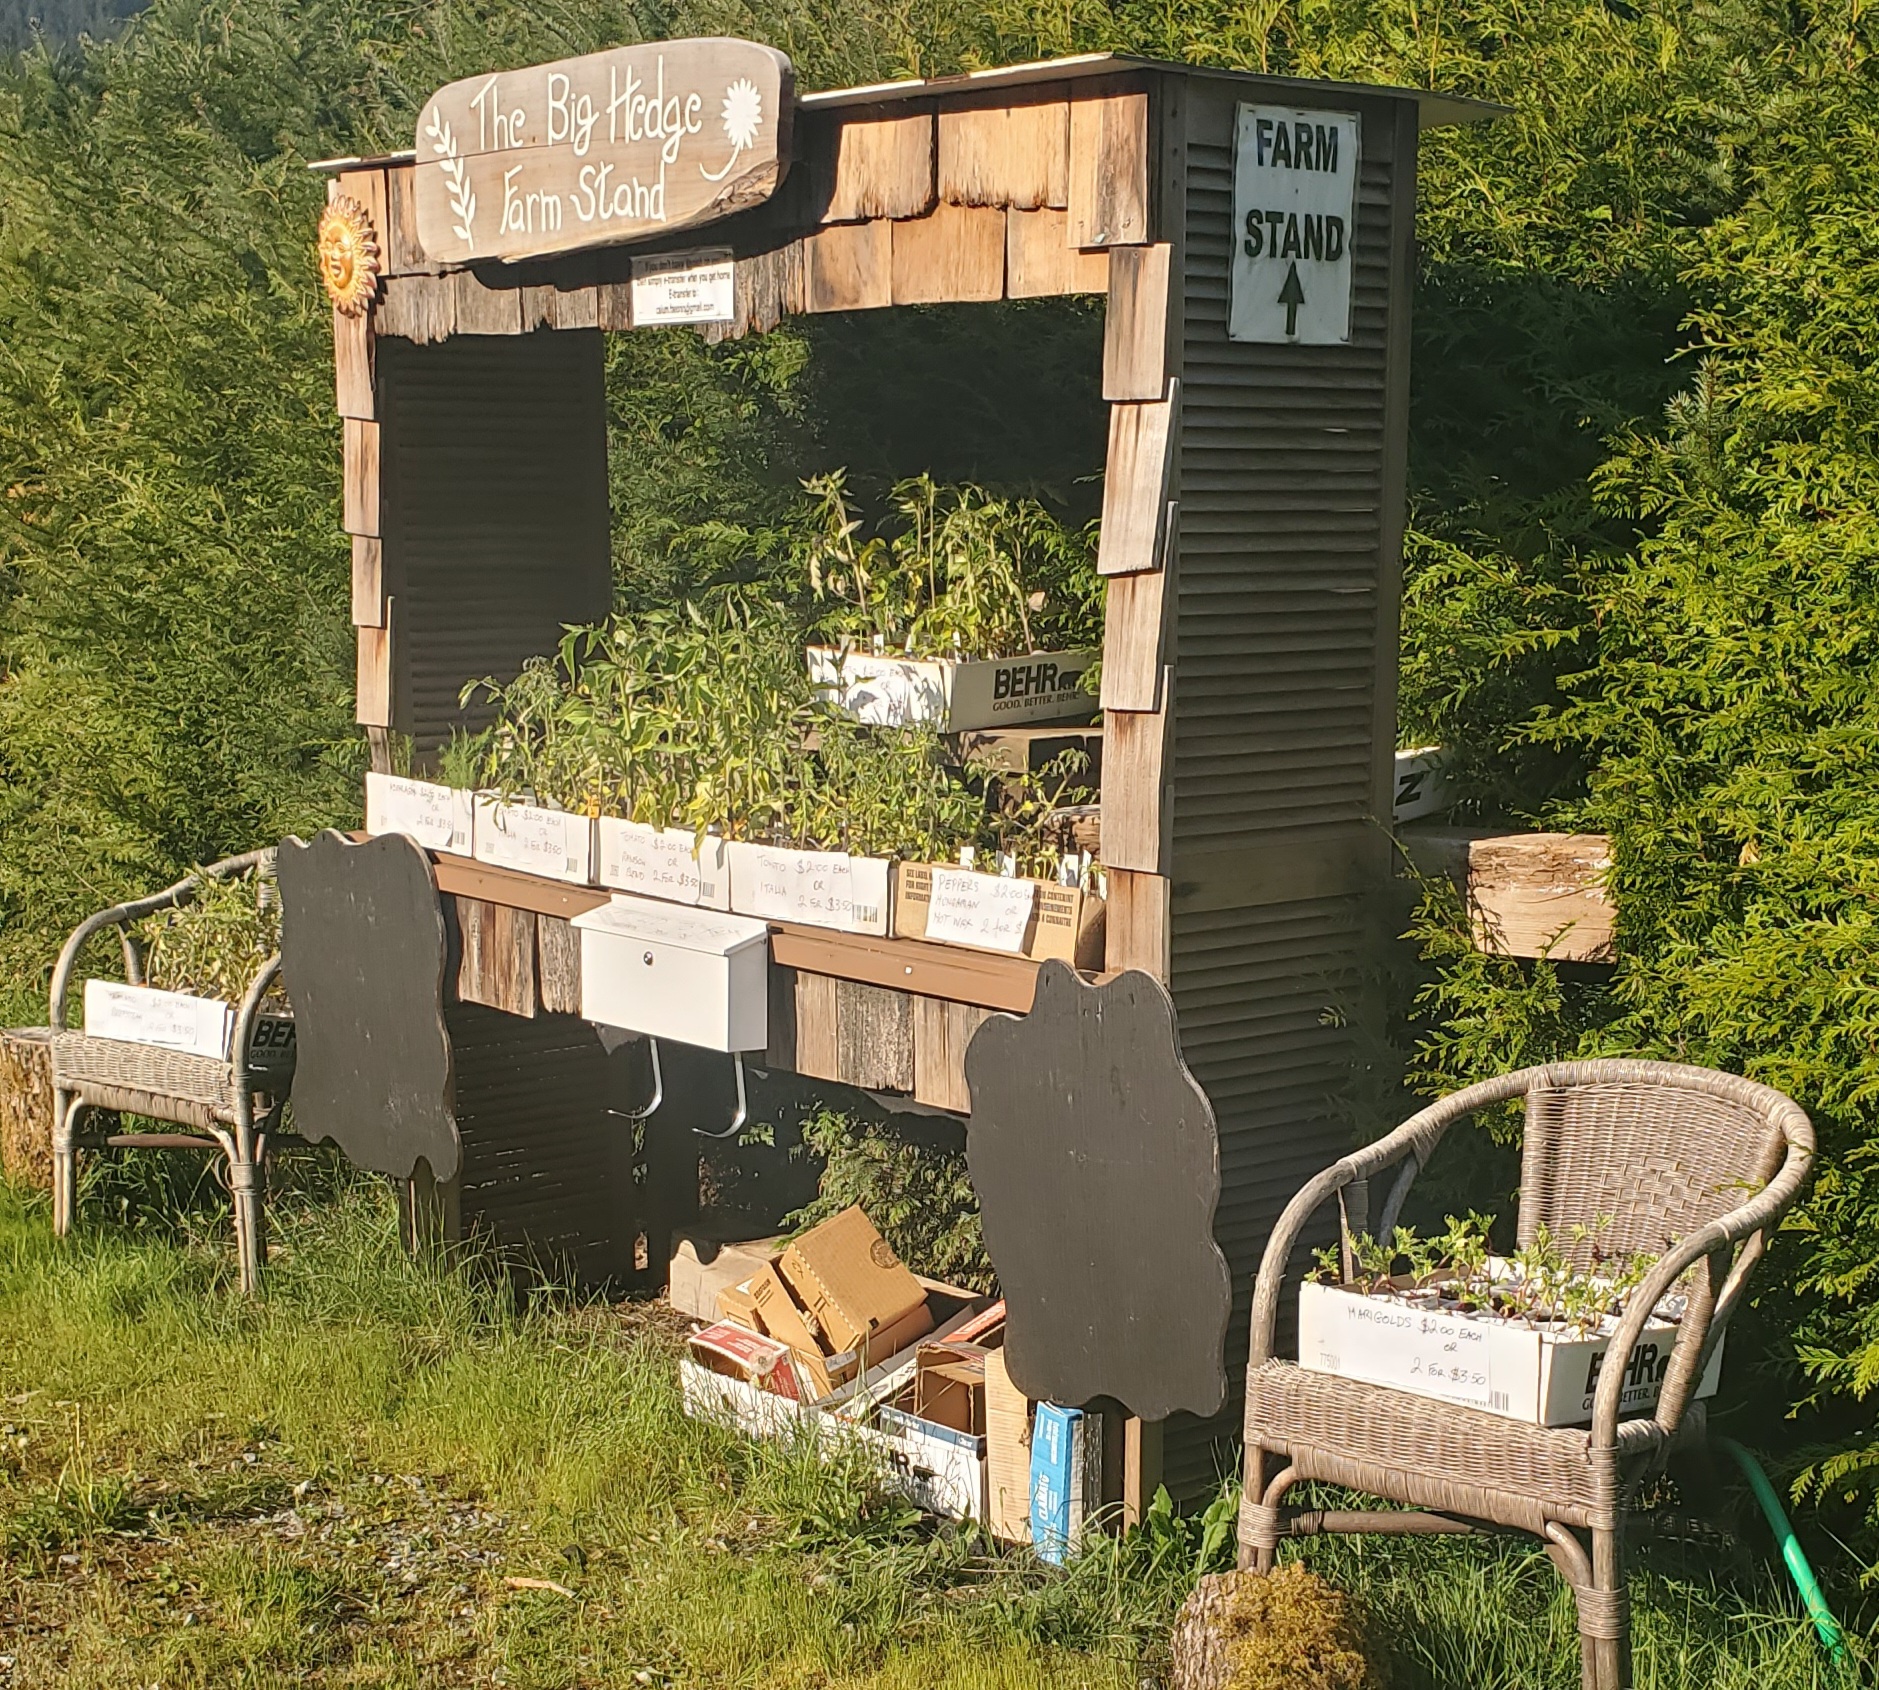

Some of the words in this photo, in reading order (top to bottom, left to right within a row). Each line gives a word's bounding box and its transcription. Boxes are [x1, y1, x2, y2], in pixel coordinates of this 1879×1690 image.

[470, 75, 525, 150] The
[548, 73, 599, 156] Big
[606, 55, 701, 163] Hedge
[1256, 119, 1338, 173] FARM
[500, 164, 562, 234] Farm
[570, 160, 667, 222] Stand
[1244, 209, 1344, 261] STAND
[994, 662, 1059, 699] BEHR
[797, 894, 808, 908] 2
[938, 873, 980, 892] PEPPERS
[933, 912, 952, 926] HOT
[980, 917, 990, 933] 2
[1347, 1305, 1412, 1329] MARIGOLDS
[1458, 1328, 1483, 1342] EACH
[1443, 1341, 1459, 1352] OR
[1409, 1356, 1423, 1375] 2
[1585, 1343, 1659, 1395] BHR
[1038, 1471, 1051, 1521] CLAMATO
